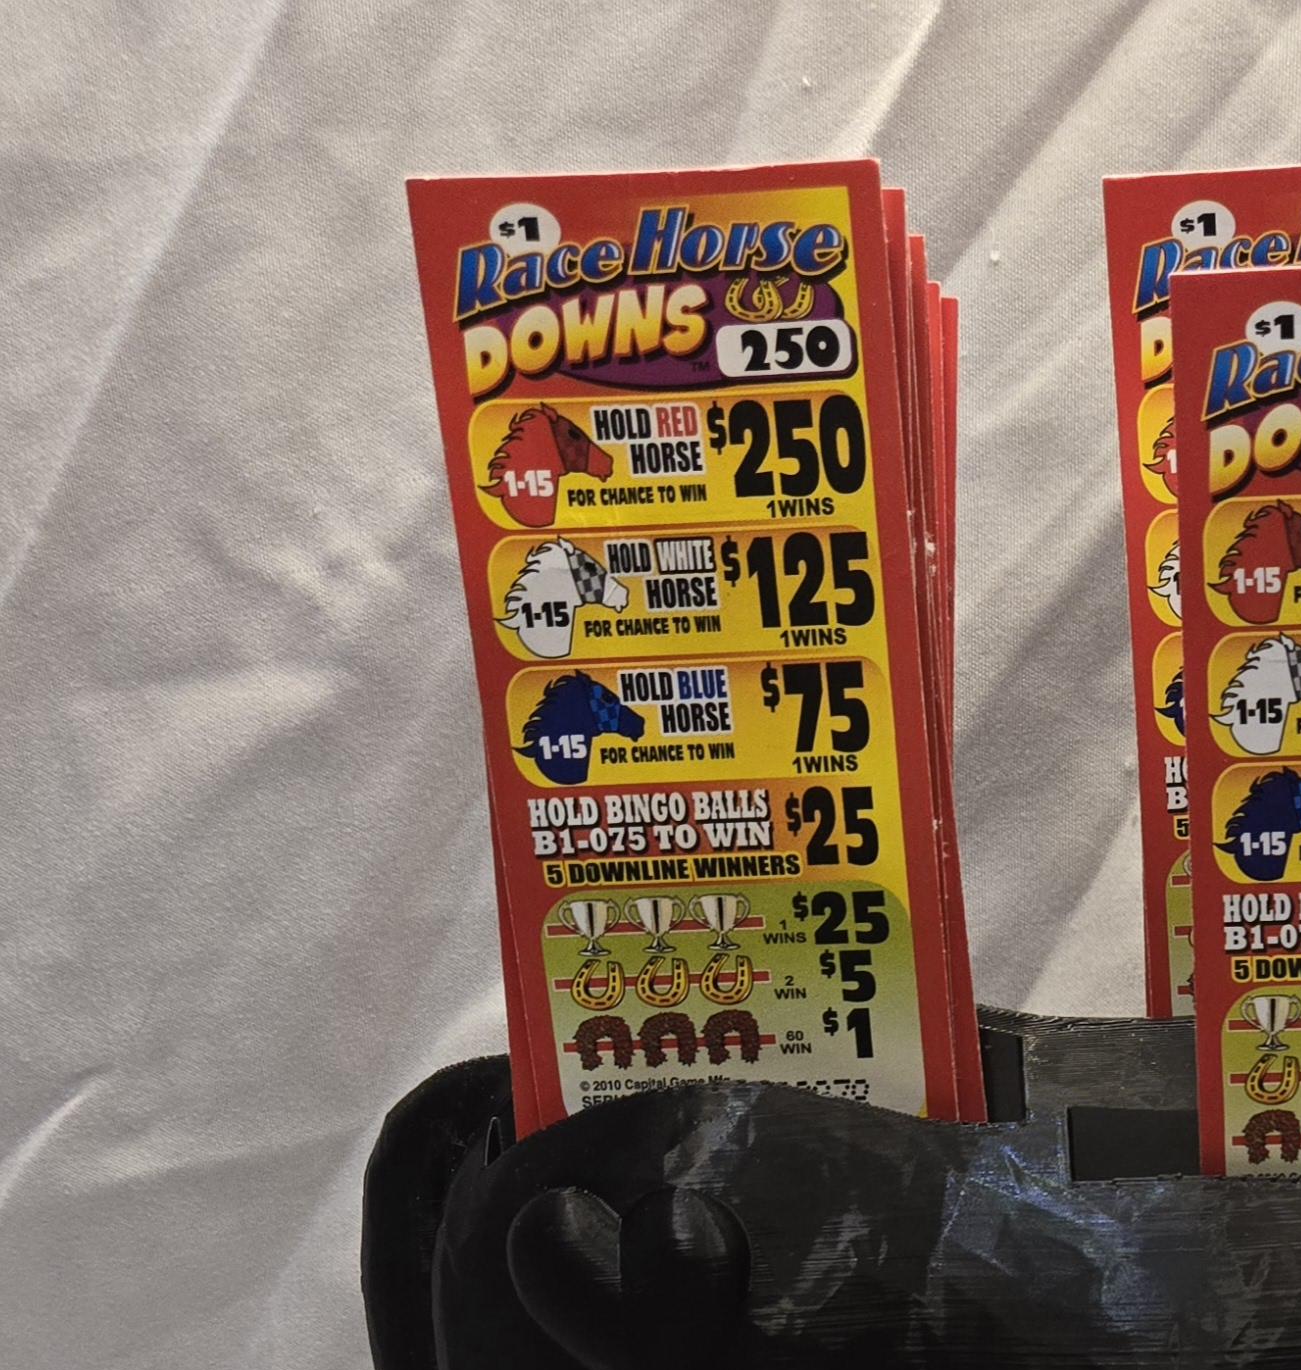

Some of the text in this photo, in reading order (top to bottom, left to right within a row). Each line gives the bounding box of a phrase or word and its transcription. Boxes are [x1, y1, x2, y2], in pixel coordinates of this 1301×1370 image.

[498, 217, 540, 242] $1
[1180, 213, 1216, 236] $1
[454, 204, 843, 321] Race Horse
[1255, 315, 1295, 339] $1
[464, 285, 708, 398] DOWNS
[741, 325, 839, 370] 250
[594, 406, 698, 440] HOLD RED
[631, 441, 703, 475] HORSE
[707, 395, 866, 497] $250
[504, 470, 553, 497] 1-15
[568, 484, 707, 506] FOR CHANCE TO WIN
[607, 539, 714, 573] HOLD WHITE
[647, 578, 717, 608] HORSE
[720, 532, 875, 628] $125
[1233, 567, 1281, 594] 1-15
[521, 602, 569, 628] 1-15
[584, 616, 721, 638] FOR CHANCE TO WIN
[621, 670, 727, 701] HOLD BLUE
[662, 703, 731, 733] HORSE
[760, 661, 870, 753] $75
[1236, 699, 1282, 725] 1-15
[538, 735, 587, 760] 1-15
[601, 743, 735, 764] FOR CHANCE TO WIN
[528, 789, 768, 828] HOLD BINGO BALLS
[653, 823, 697, 850] TO
[703, 822, 772, 848] WIN
[785, 786, 879, 866] $25
[1240, 832, 1286, 856] 1-15
[547, 854, 801, 884] 5 DOWNLINE WINNERS
[792, 890, 889, 945] $25
[1223, 894, 1292, 923] HOLD
[763, 933, 806, 944] WINS
[779, 920, 786, 930] 1
[785, 976, 794, 986] 2
[819, 949, 876, 1002] $5
[1234, 960, 1250, 980] 5
[774, 988, 806, 999] WIN
[786, 1031, 804, 1040] 60
[823, 1007, 873, 1058] $1
[780, 1043, 812, 1054] WIN
[592, 1078, 667, 1092] 2010 Capital
